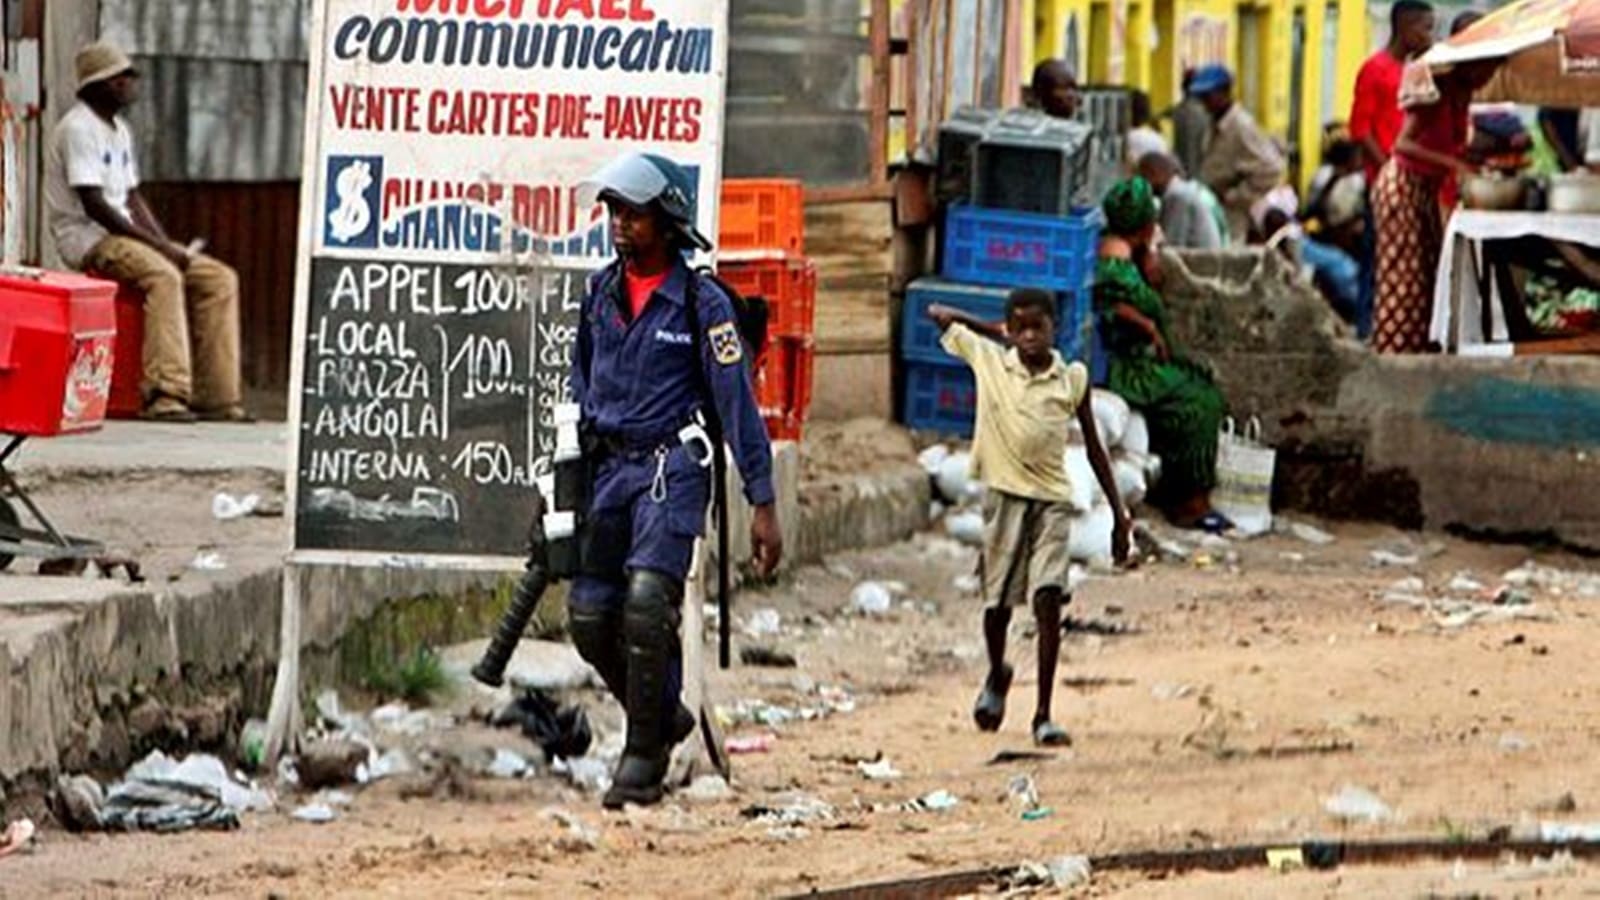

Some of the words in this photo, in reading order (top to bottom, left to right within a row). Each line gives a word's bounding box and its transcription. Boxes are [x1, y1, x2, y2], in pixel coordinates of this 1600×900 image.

[333, 15, 713, 74] communication
[329, 85, 421, 132] VENTE
[427, 89, 538, 138] CARTES
[543, 94, 702, 142] PRE-PAYEES
[382, 177, 504, 252] CHANGE
[511, 183, 615, 258] DOLLA
[330, 264, 457, 315] APPEL
